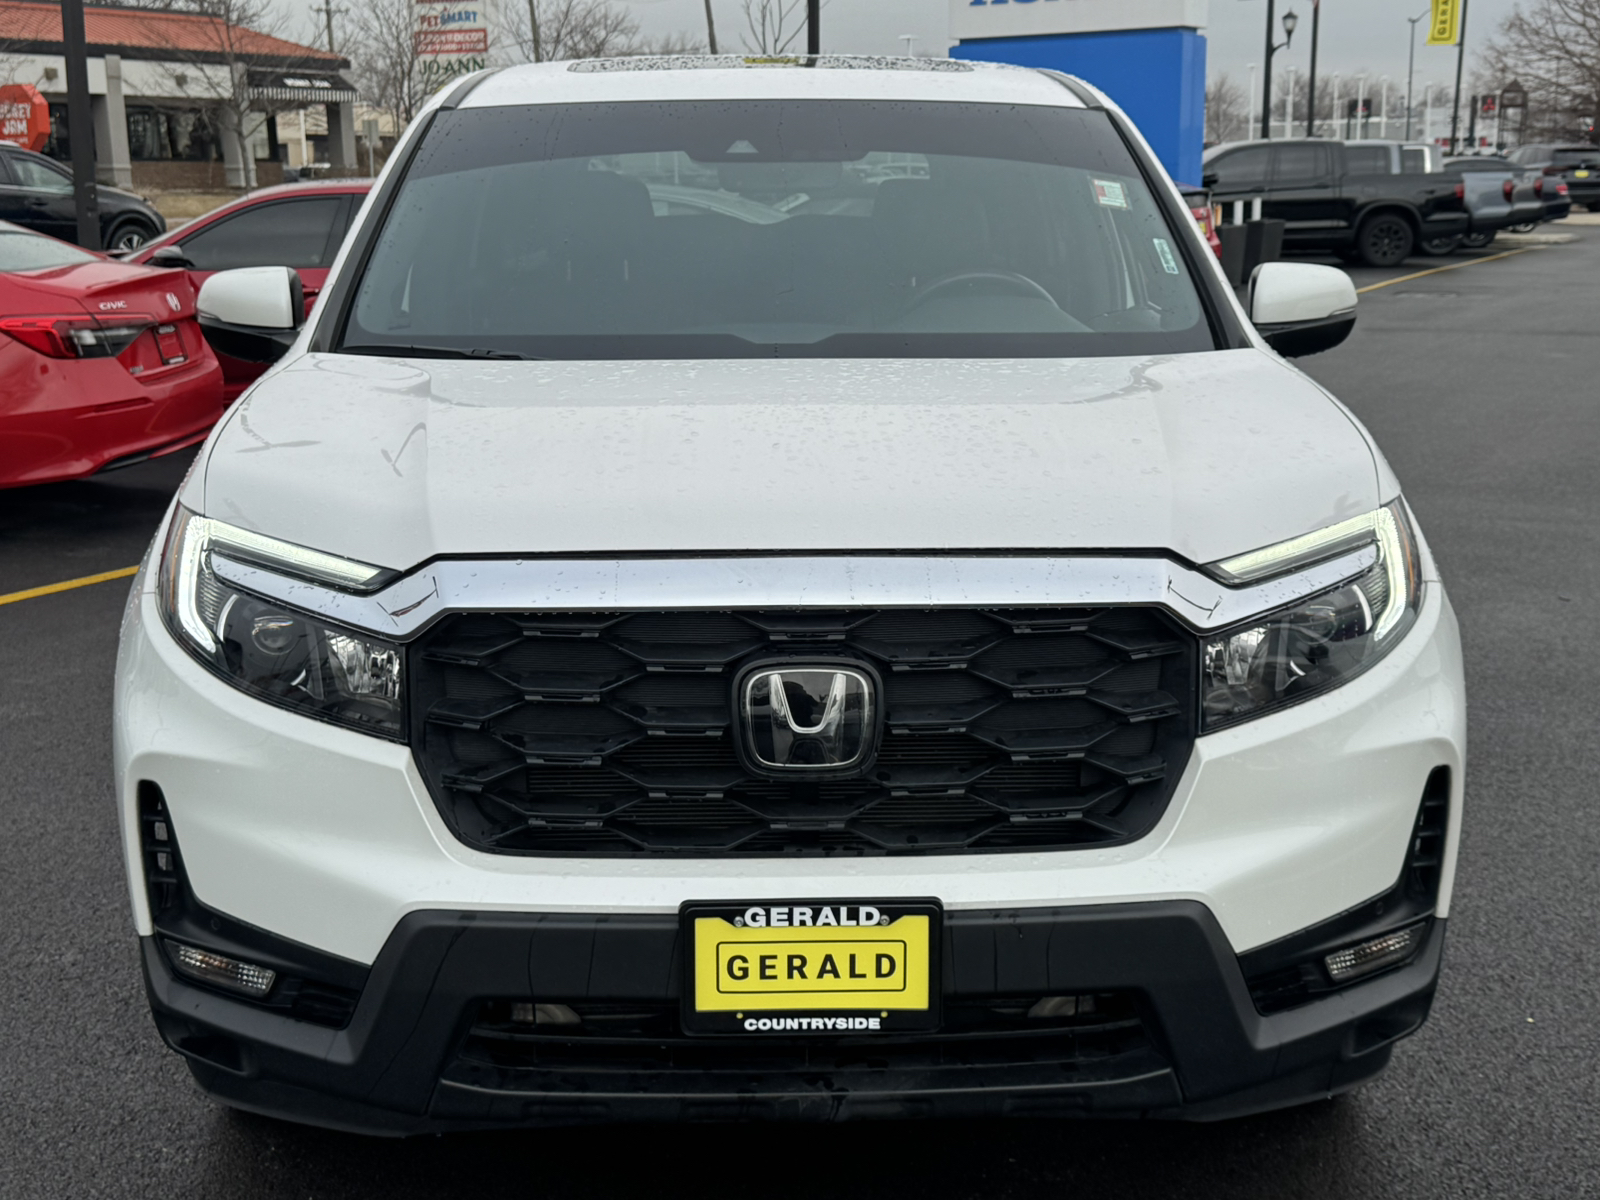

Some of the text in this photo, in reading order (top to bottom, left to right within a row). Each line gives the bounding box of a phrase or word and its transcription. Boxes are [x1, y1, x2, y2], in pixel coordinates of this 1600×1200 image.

[99, 300, 127, 310] CIVIC
[744, 906, 881, 928] GERALD
[726, 953, 897, 981] GERALD
[744, 1017, 881, 1031] COUNTRYSIDE
